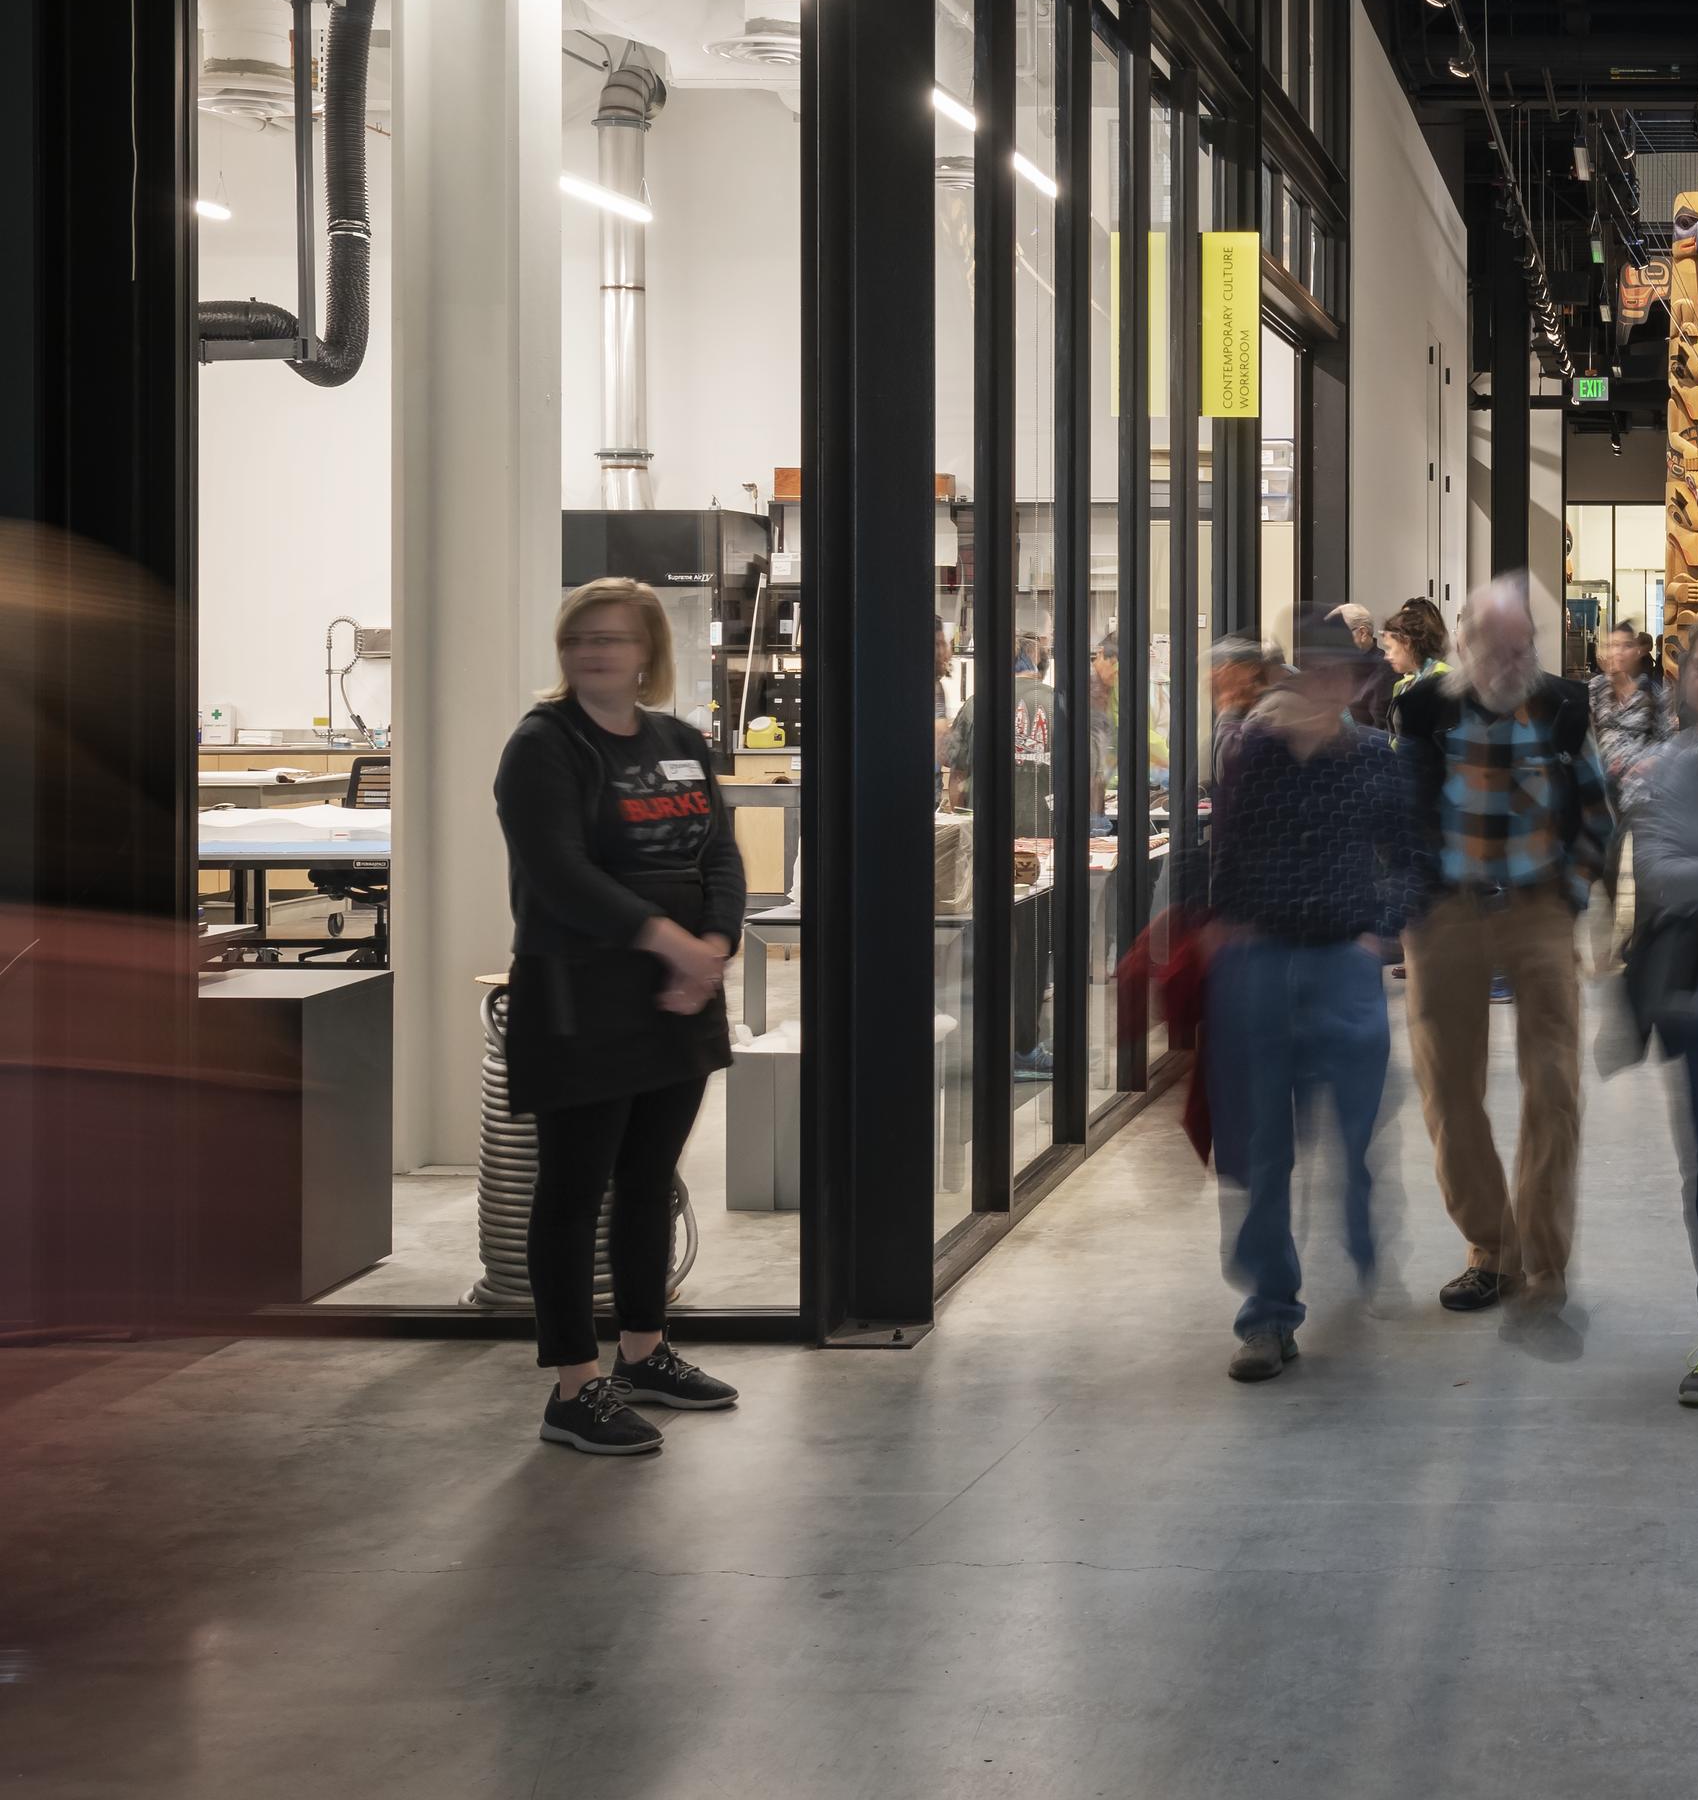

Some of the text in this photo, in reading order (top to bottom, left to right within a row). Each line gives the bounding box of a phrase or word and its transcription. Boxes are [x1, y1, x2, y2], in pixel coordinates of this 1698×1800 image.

[1222, 247, 1234, 409] CONTEMPORARY CULTURE
[1239, 329, 1250, 409] WORKROOM
[1579, 379, 1604, 398] EXIT
[622, 791, 711, 822] BURKE
